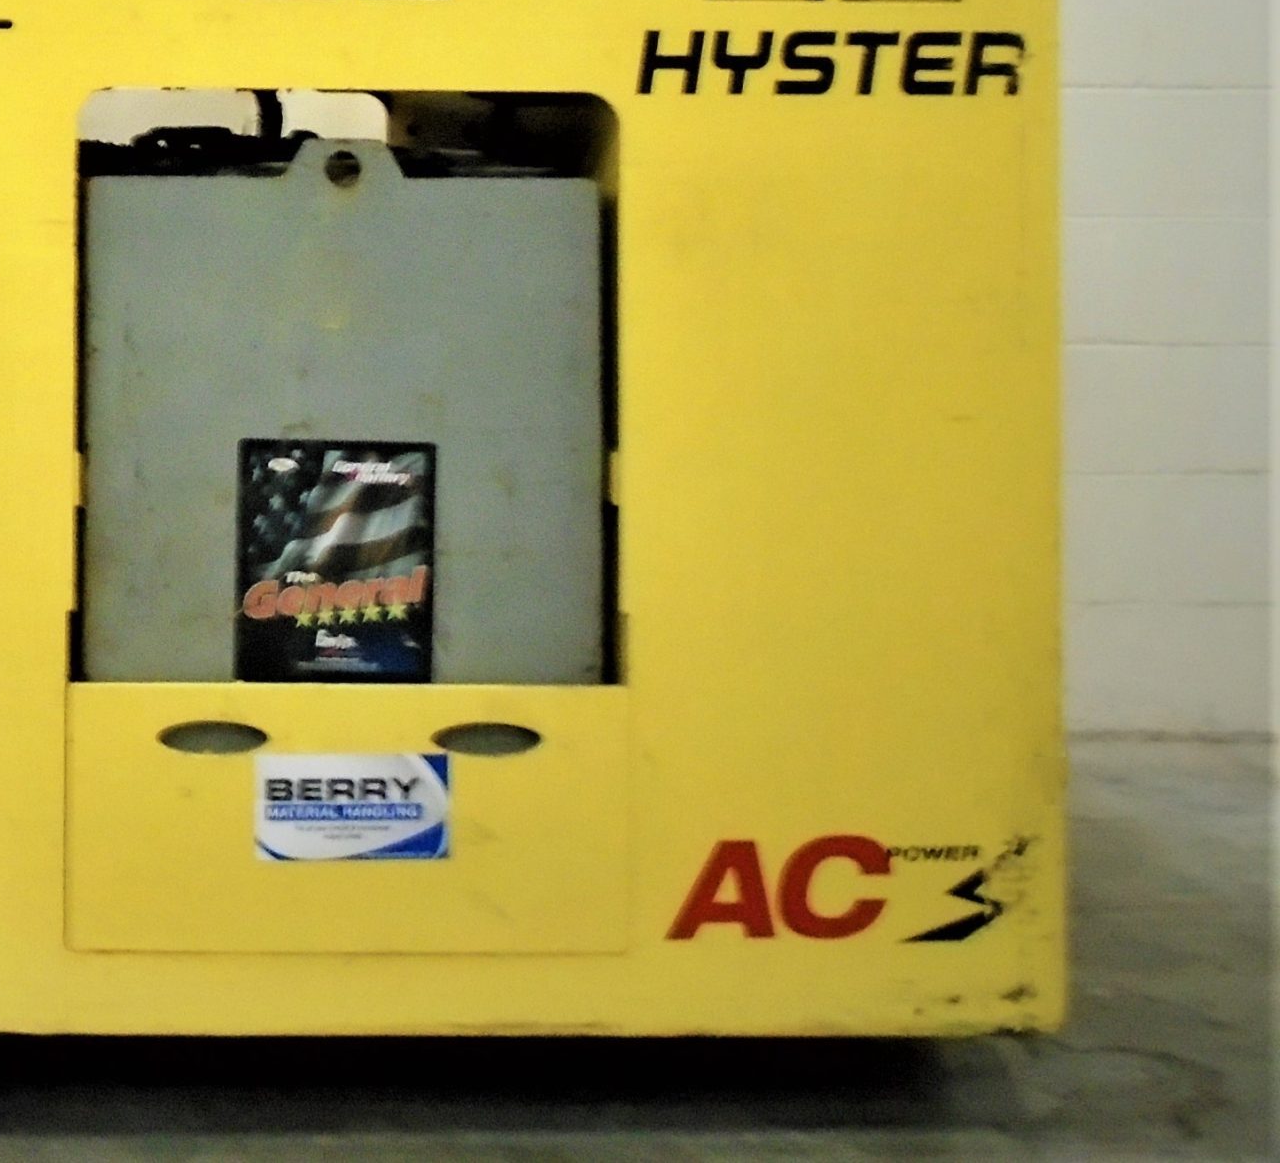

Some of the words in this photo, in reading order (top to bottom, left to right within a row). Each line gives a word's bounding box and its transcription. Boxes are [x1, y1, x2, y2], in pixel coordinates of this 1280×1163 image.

[635, 30, 1026, 96] HYSTER
[265, 777, 420, 801] BERRY
[267, 804, 339, 819] MATERIAL
[342, 804, 418, 819] HANDLING
[886, 843, 980, 862] POWER
[664, 834, 891, 940] AC
